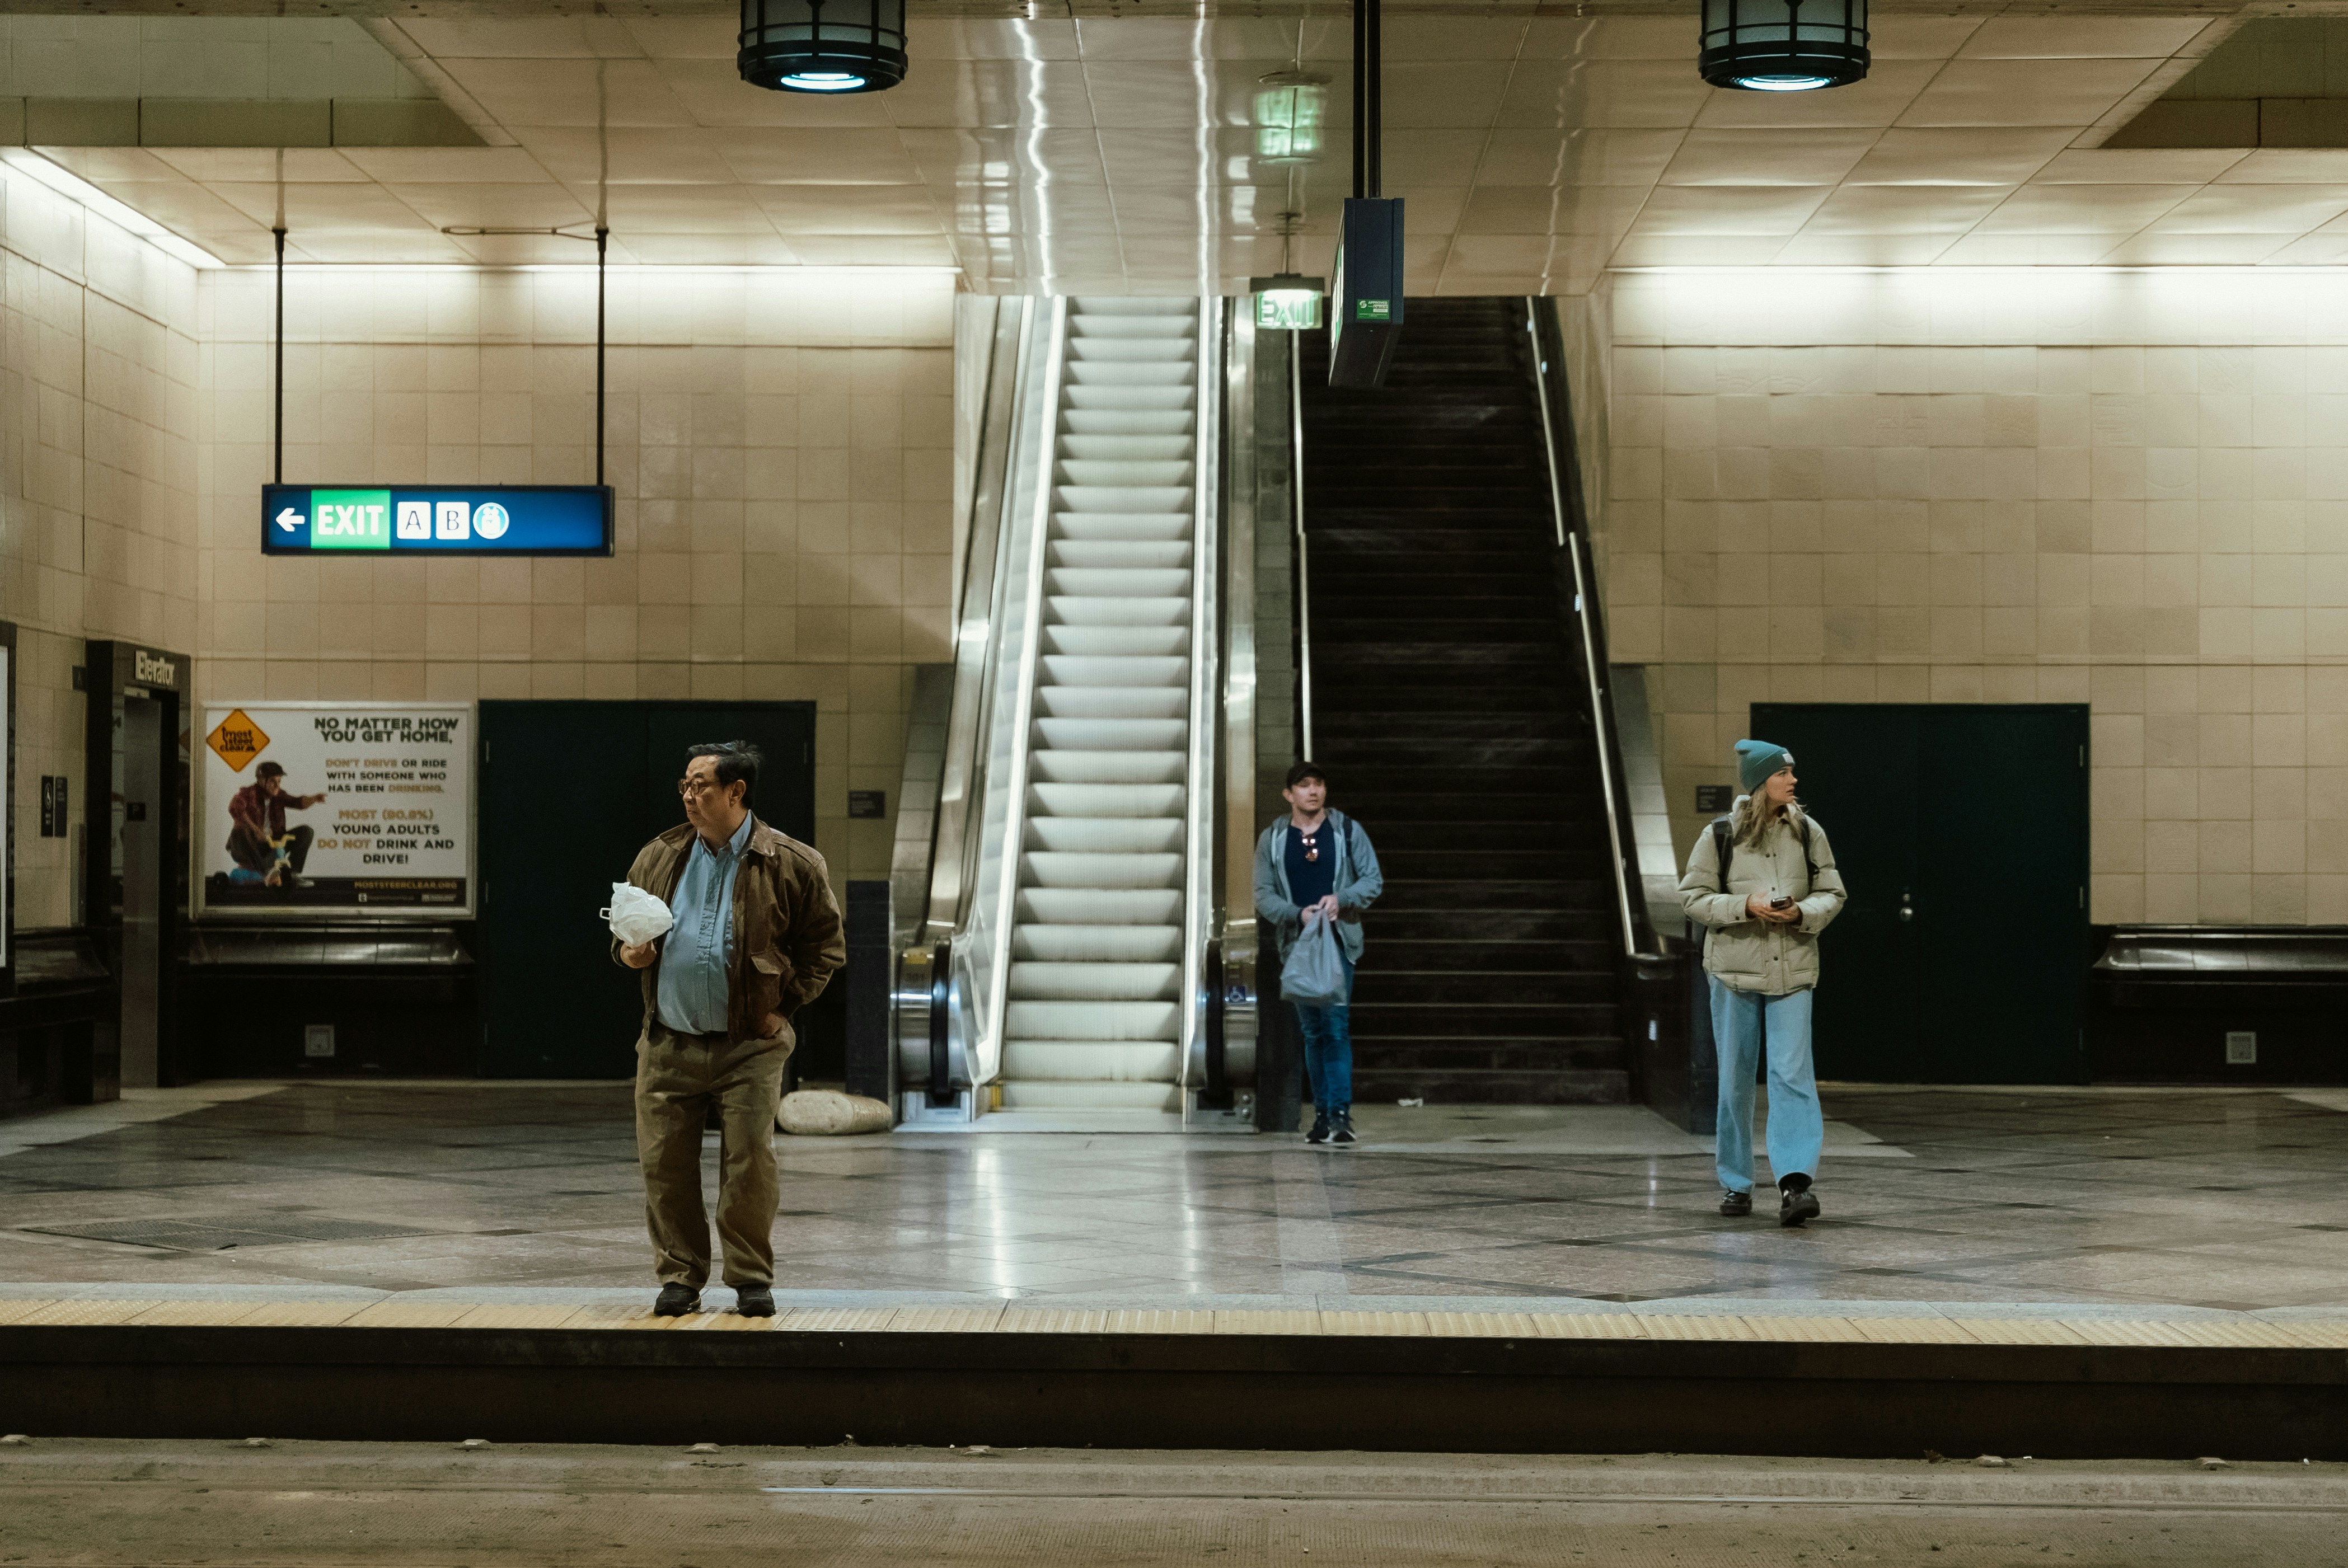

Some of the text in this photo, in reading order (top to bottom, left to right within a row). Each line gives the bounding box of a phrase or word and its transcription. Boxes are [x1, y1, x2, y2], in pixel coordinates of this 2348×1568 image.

[1260, 289, 1318, 326] EXIT
[317, 505, 460, 536] EXIT A B
[135, 650, 175, 686] Elevator
[314, 718, 458, 730] NO MATTER HOW
[321, 731, 453, 745] YOU GET HOME,
[325, 758, 447, 768] DON'T DRIVE OR RIDE
[327, 771, 447, 781] WITH SOMEONE WHO
[328, 784, 351, 794] HAS
[355, 784, 385, 794] BEEN
[338, 809, 377, 820] MOST
[332, 824, 440, 835] YOUNG ADULTS
[317, 839, 454, 849] DO NOT DRINK AND
[363, 853, 409, 865] DRIVE!
